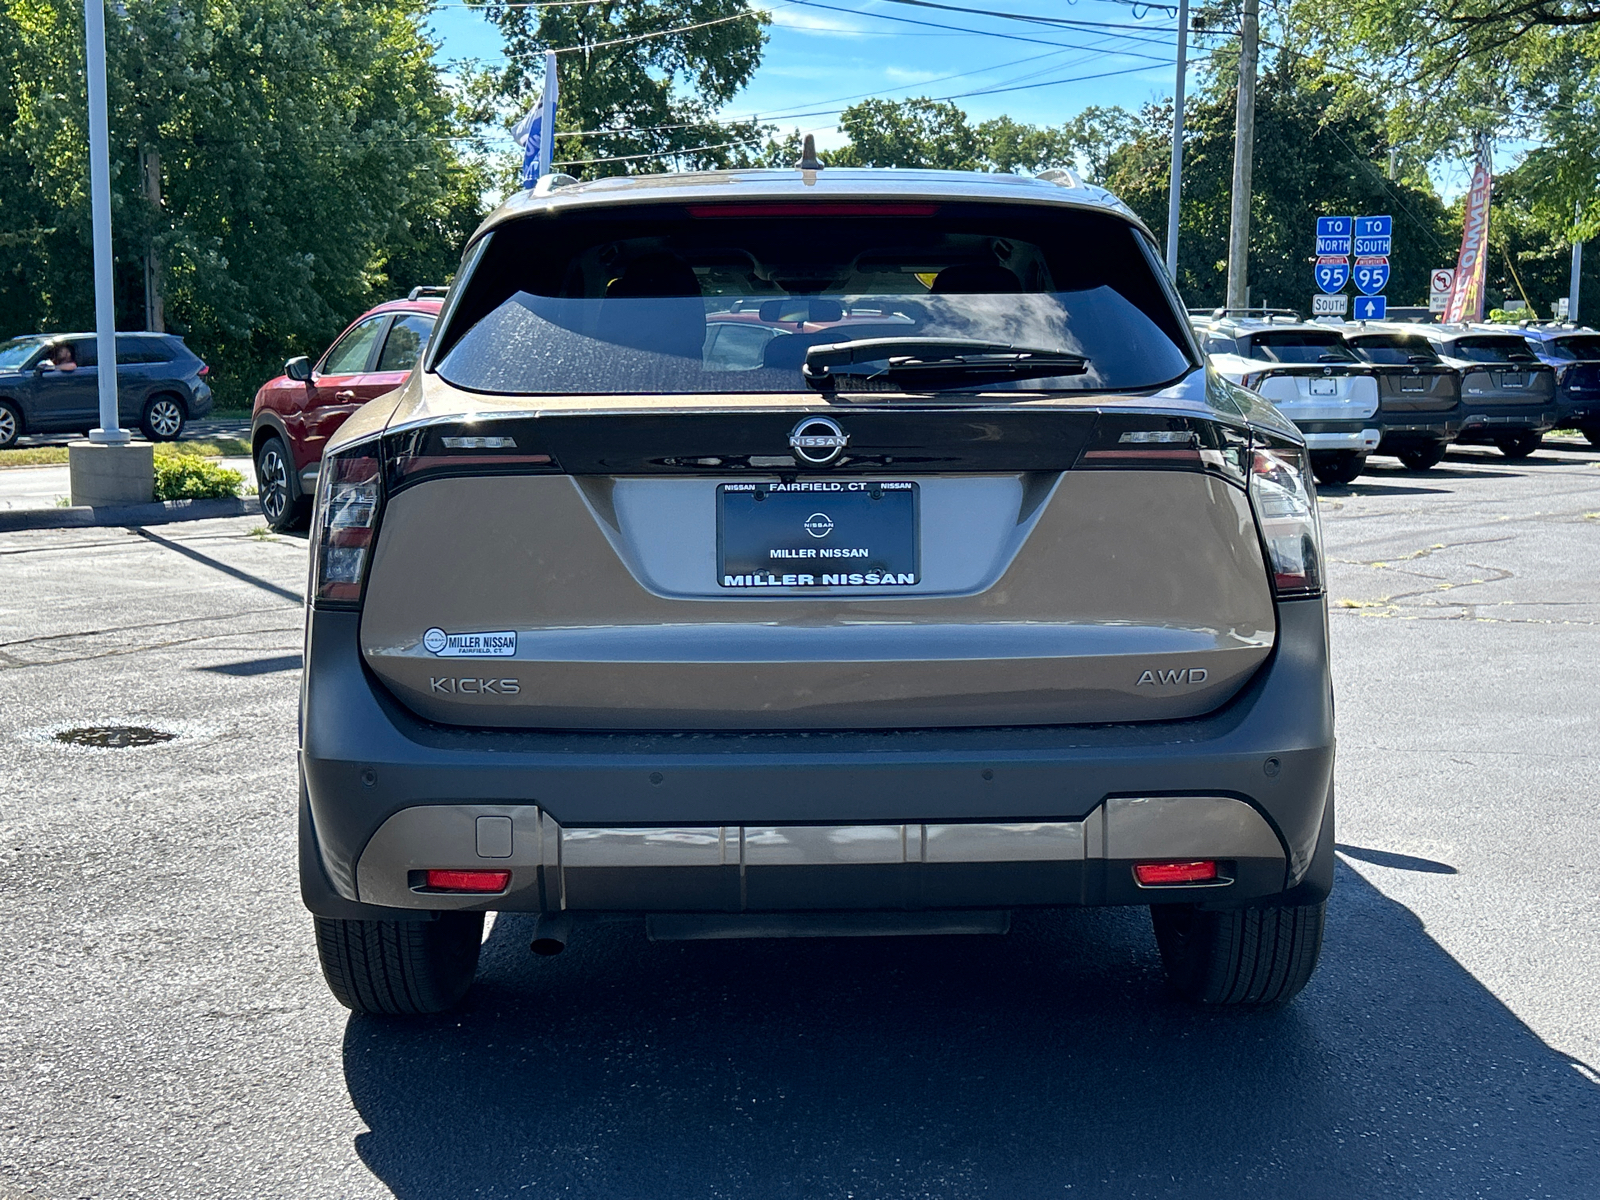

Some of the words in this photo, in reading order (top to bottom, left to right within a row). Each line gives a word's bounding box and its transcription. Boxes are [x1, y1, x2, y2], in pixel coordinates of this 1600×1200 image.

[1327, 221, 1343, 232] TO
[1365, 221, 1382, 232] TO
[1318, 239, 1349, 251] NORTH
[1356, 240, 1389, 252] SOUTH
[1320, 269, 1344, 286] 95
[1359, 269, 1384, 287] 95
[1316, 299, 1345, 311] SOUTH
[790, 437, 847, 446] NISSAN
[770, 484, 845, 492] FAIRFIELD,
[848, 483, 867, 491] CT
[770, 550, 816, 558] MILLER
[820, 549, 868, 557] NISSAN
[725, 575, 814, 586] MILLER
[823, 574, 914, 584] NISSAN
[448, 637, 480, 648] MILLER
[483, 637, 514, 648] NISSAN
[1136, 667, 1209, 686] AWD
[430, 677, 521, 695] KICKS
